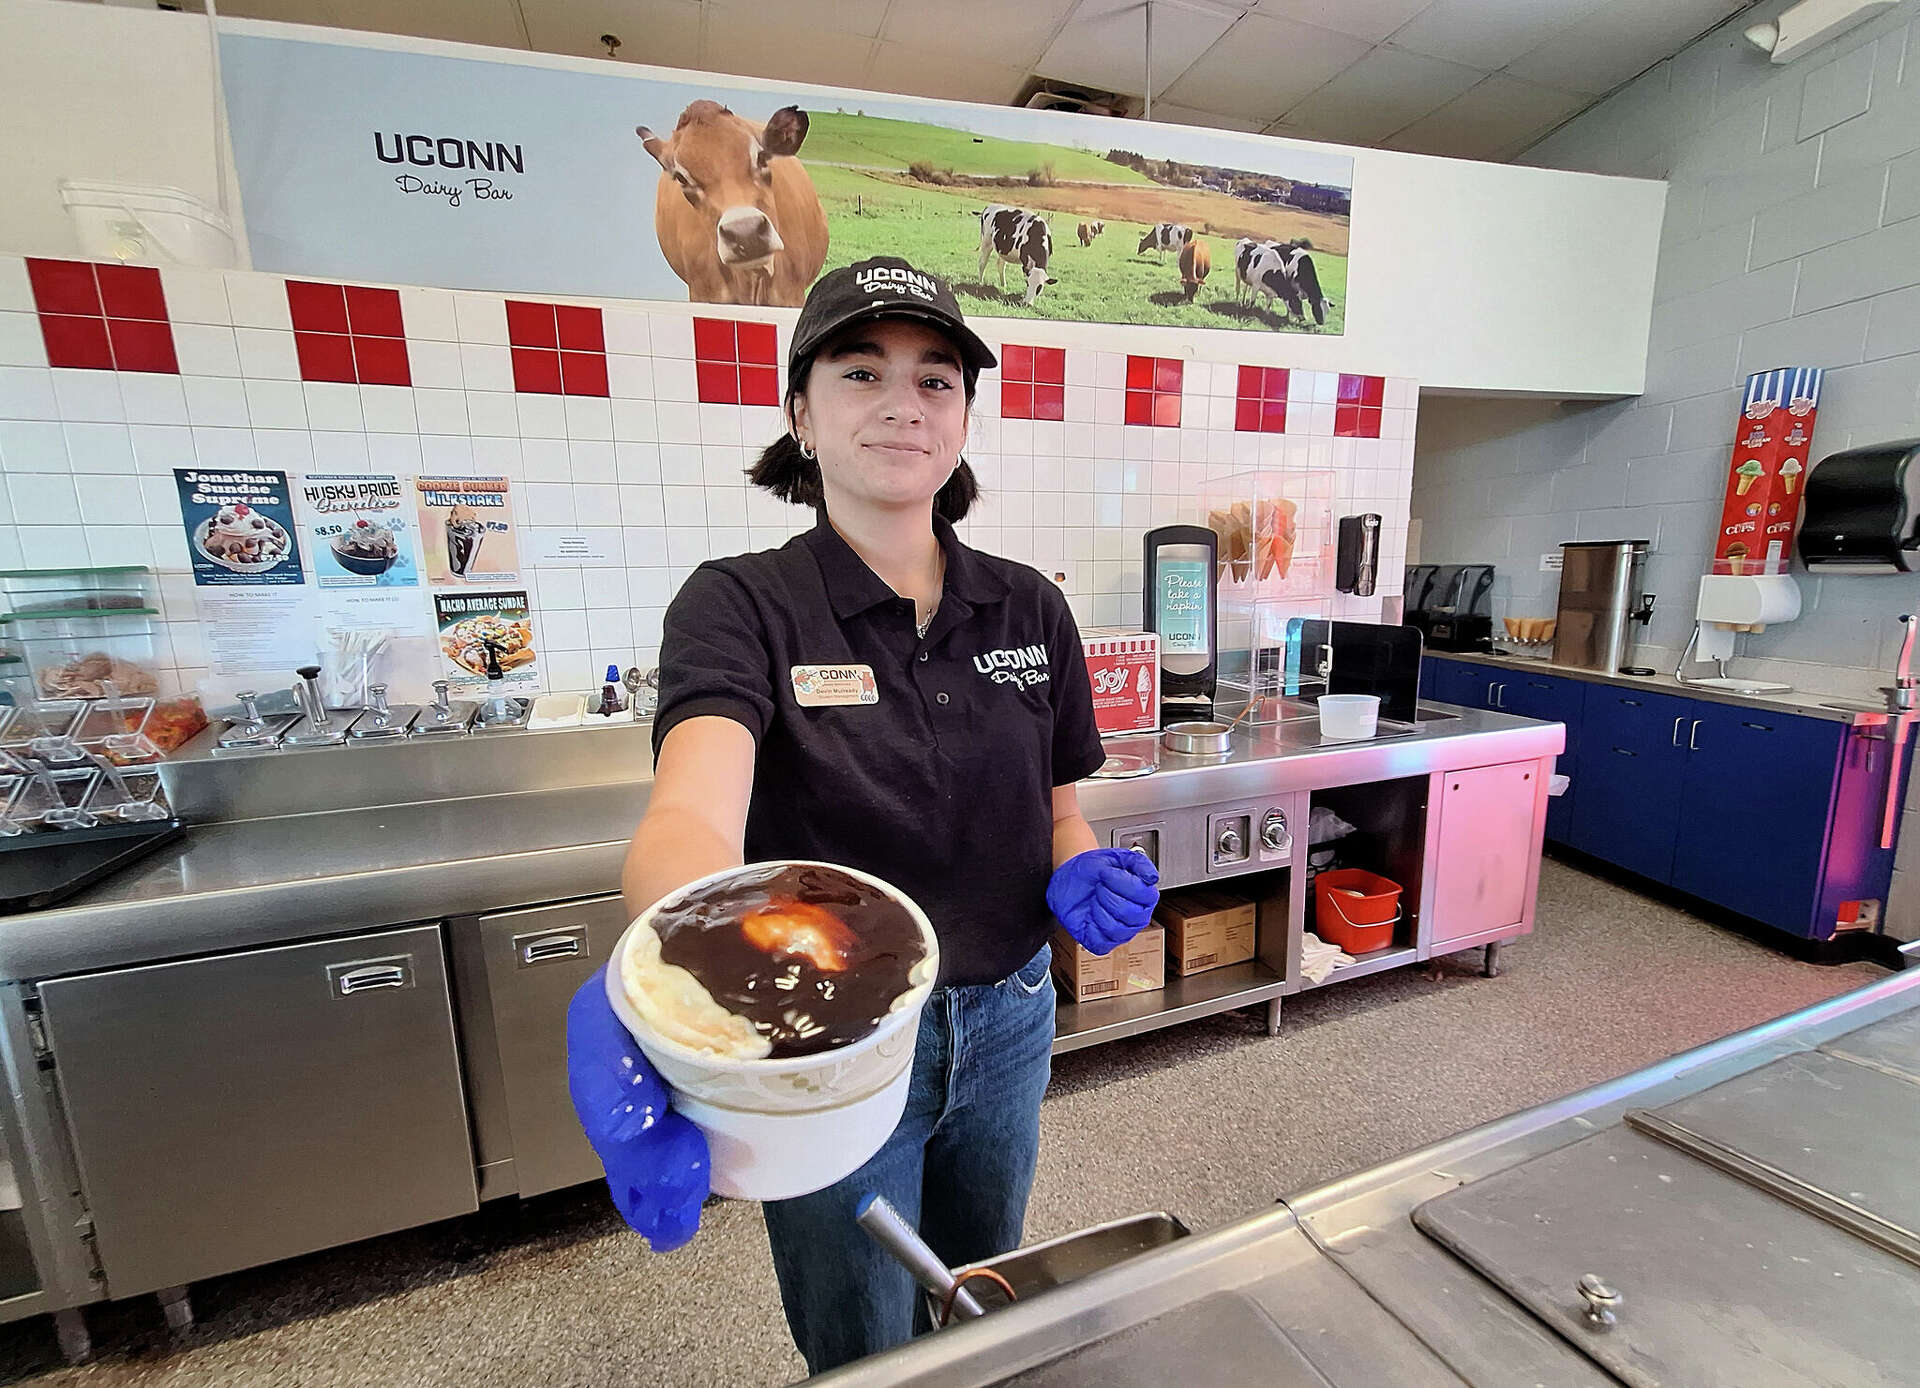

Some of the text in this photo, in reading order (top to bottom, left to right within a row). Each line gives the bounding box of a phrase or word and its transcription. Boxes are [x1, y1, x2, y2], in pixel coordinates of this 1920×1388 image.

[374, 132, 525, 173] UCONN
[395, 174, 513, 207] Dairy Bar
[856, 267, 938, 295] UCONN
[863, 281, 934, 301] Dairy Bar
[184, 471, 279, 484] Jonathan
[197, 483, 271, 494] Sundae
[304, 482, 400, 501] HUSKY PRIDE
[417, 481, 508, 492] COOKIE DUNKER
[315, 525, 342, 536] $8.50
[1164, 574, 1203, 589] Please
[1168, 588, 1191, 600] take
[441, 596, 526, 613] NACHO AVERAGE SUNDAE
[1166, 600, 1203, 615] napkin
[973, 644, 1049, 674] UCONN
[1020, 669, 1050, 686] Bar
